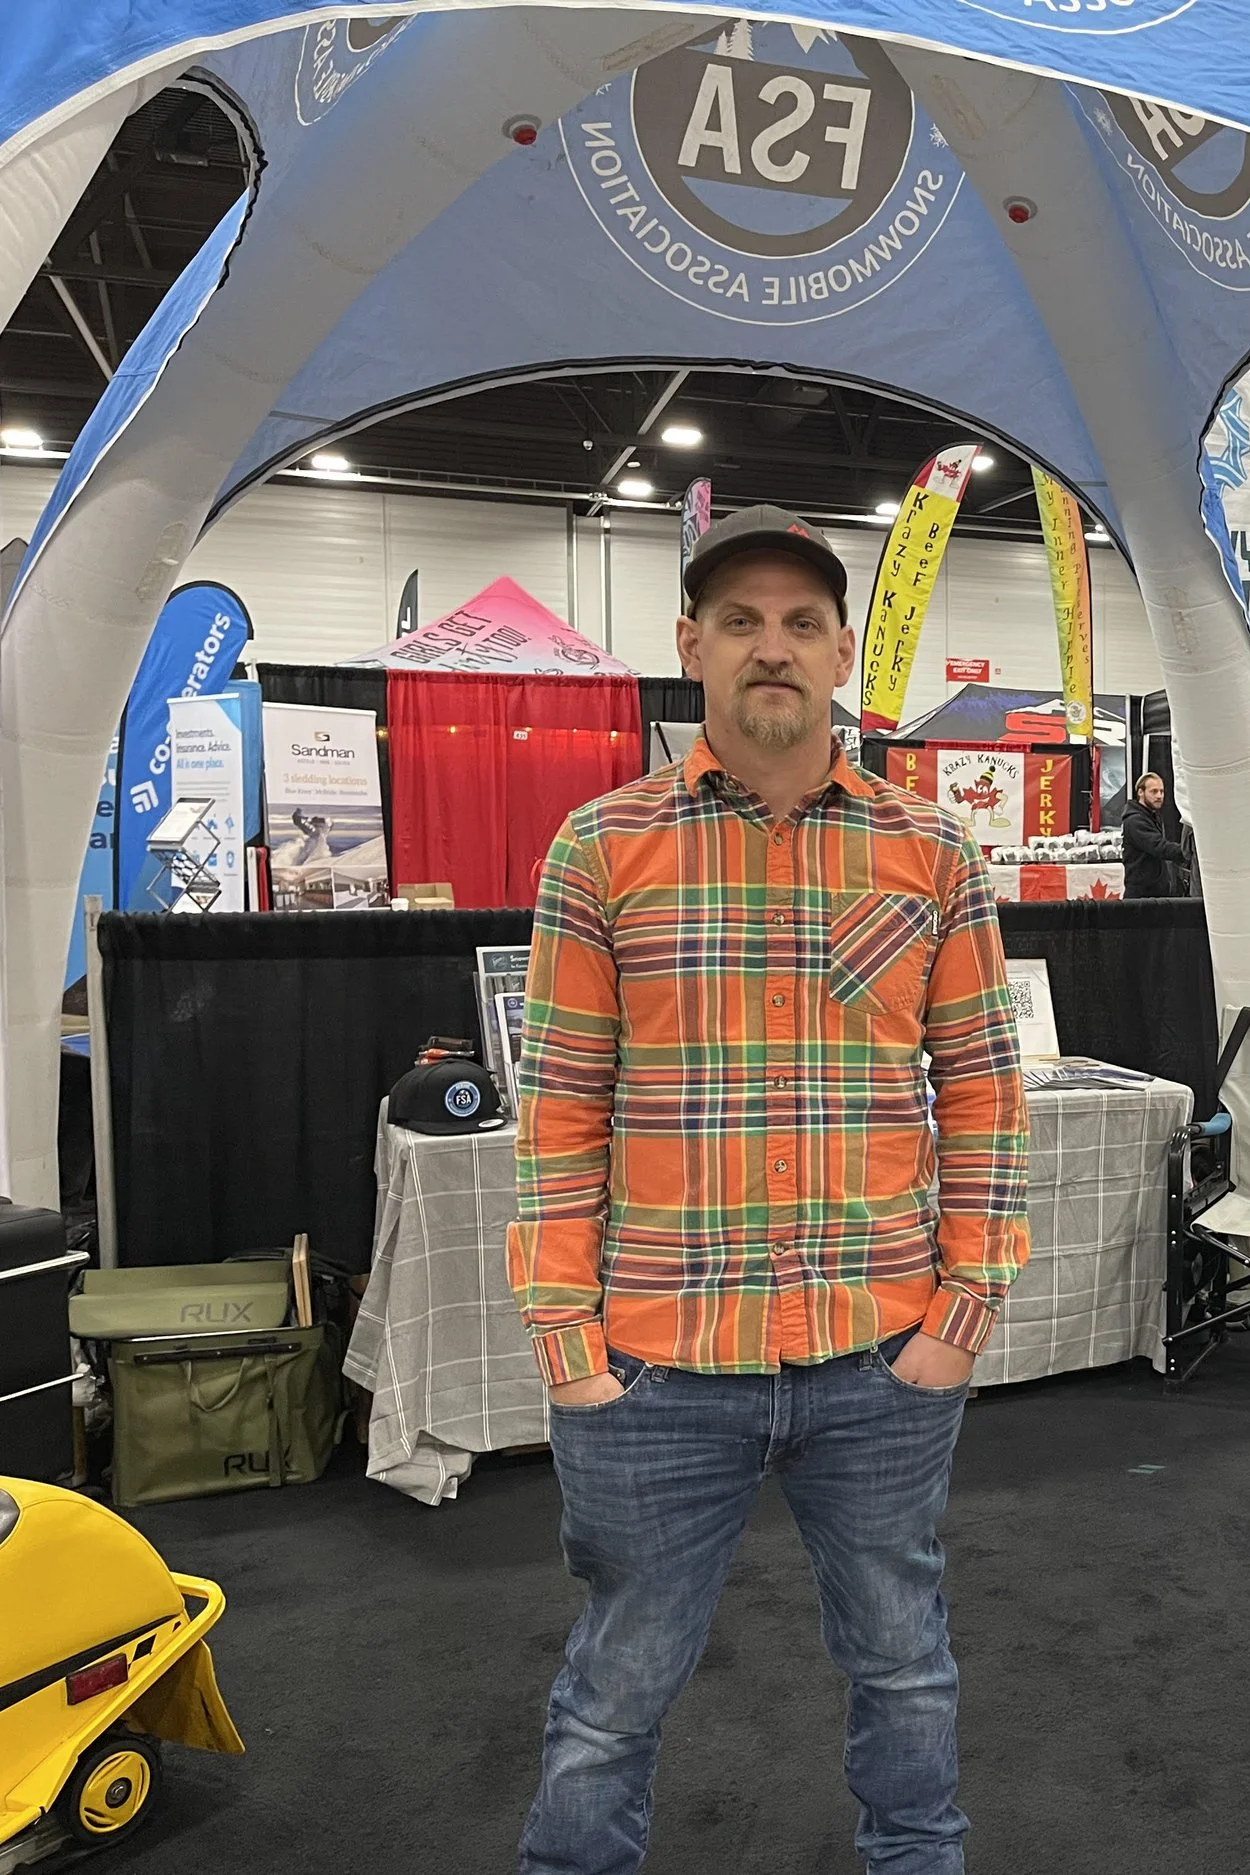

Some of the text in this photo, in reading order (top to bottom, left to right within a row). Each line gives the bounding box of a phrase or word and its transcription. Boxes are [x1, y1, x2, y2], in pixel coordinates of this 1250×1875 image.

[438, 609, 493, 638] GET
[292, 744, 354, 758] Sandman
[943, 754, 1019, 779] KRAZY KANUCKS
[456, 1095, 471, 1104] FSA
[180, 1302, 253, 1323] RUX
